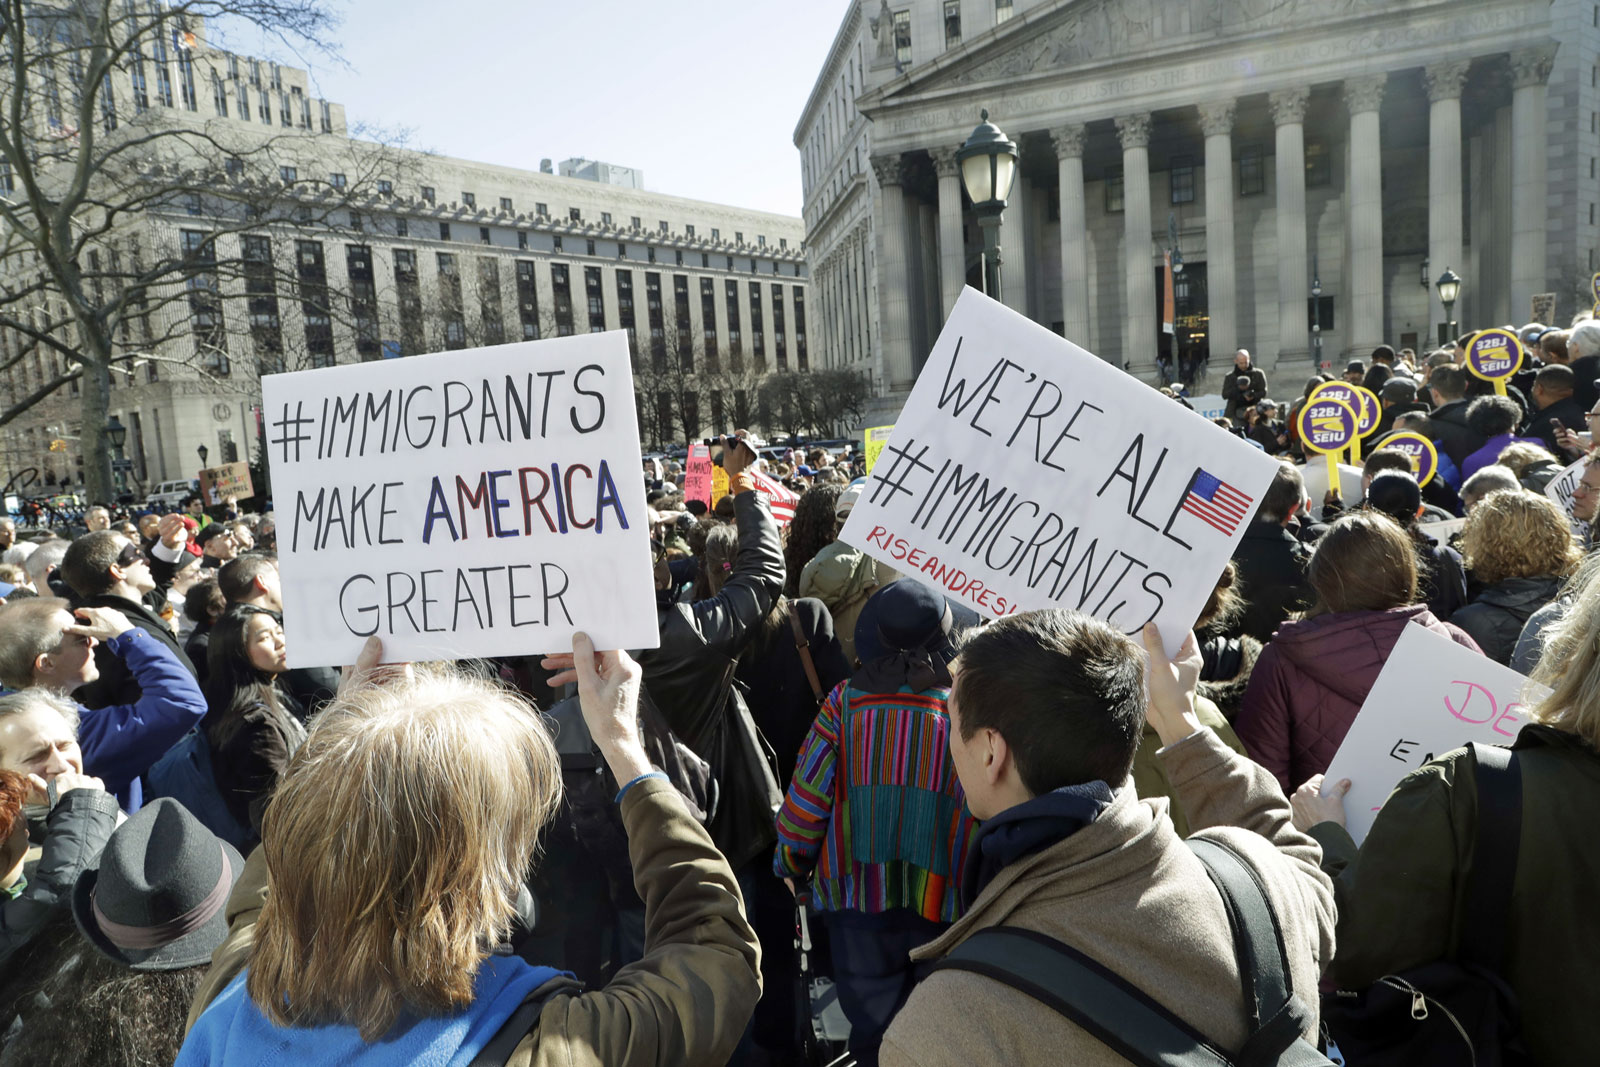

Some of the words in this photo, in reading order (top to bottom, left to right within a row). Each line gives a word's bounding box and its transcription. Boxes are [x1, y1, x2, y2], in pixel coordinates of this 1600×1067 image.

[948, 94, 1053, 122] ADMIISTRATION
[1082, 78, 1138, 99] JUSTICE
[1162, 69, 1187, 85] THE
[1476, 337, 1507, 350] 32BJ
[1480, 359, 1511, 373] SEIU
[271, 364, 606, 463] #IMMIGRANTS
[1309, 406, 1342, 418] 32BJ
[1313, 431, 1345, 444] SEIU
[292, 482, 404, 553] MAKE
[422, 459, 630, 545] AMERICA
[1096, 433, 1201, 550] ALL
[1554, 470, 1576, 505] NOT
[869, 438, 1173, 635] #IMMIGRANTS
[866, 525, 1018, 616] RISEANDRESI
[339, 563, 574, 637] GREATER
[1444, 680, 1524, 737] DE
